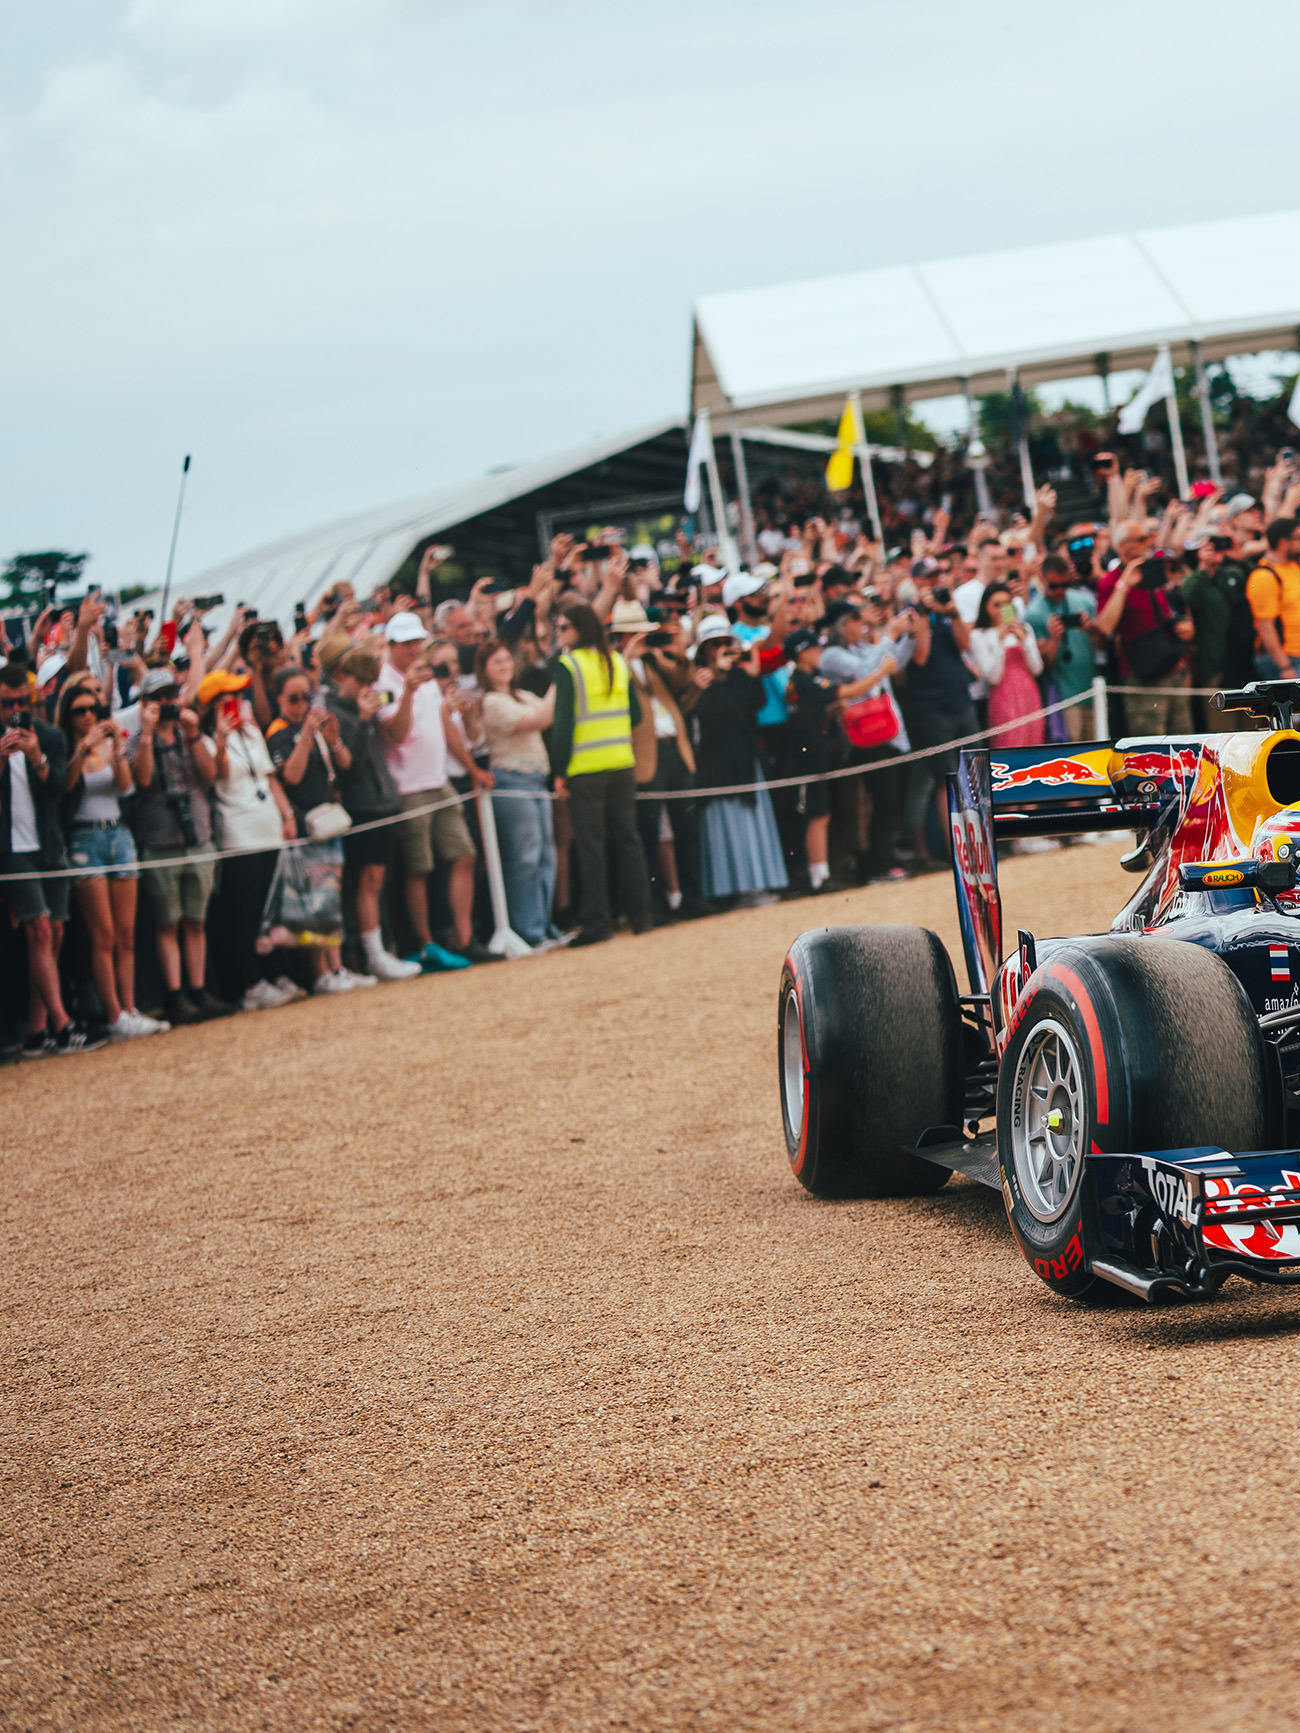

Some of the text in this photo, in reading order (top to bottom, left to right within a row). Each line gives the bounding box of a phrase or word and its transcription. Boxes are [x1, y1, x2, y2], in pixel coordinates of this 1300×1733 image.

[1213, 874, 1239, 883] RAUCH
[1013, 1065, 1027, 1128] RACING
[1142, 1158, 1199, 1226] TOTAL
